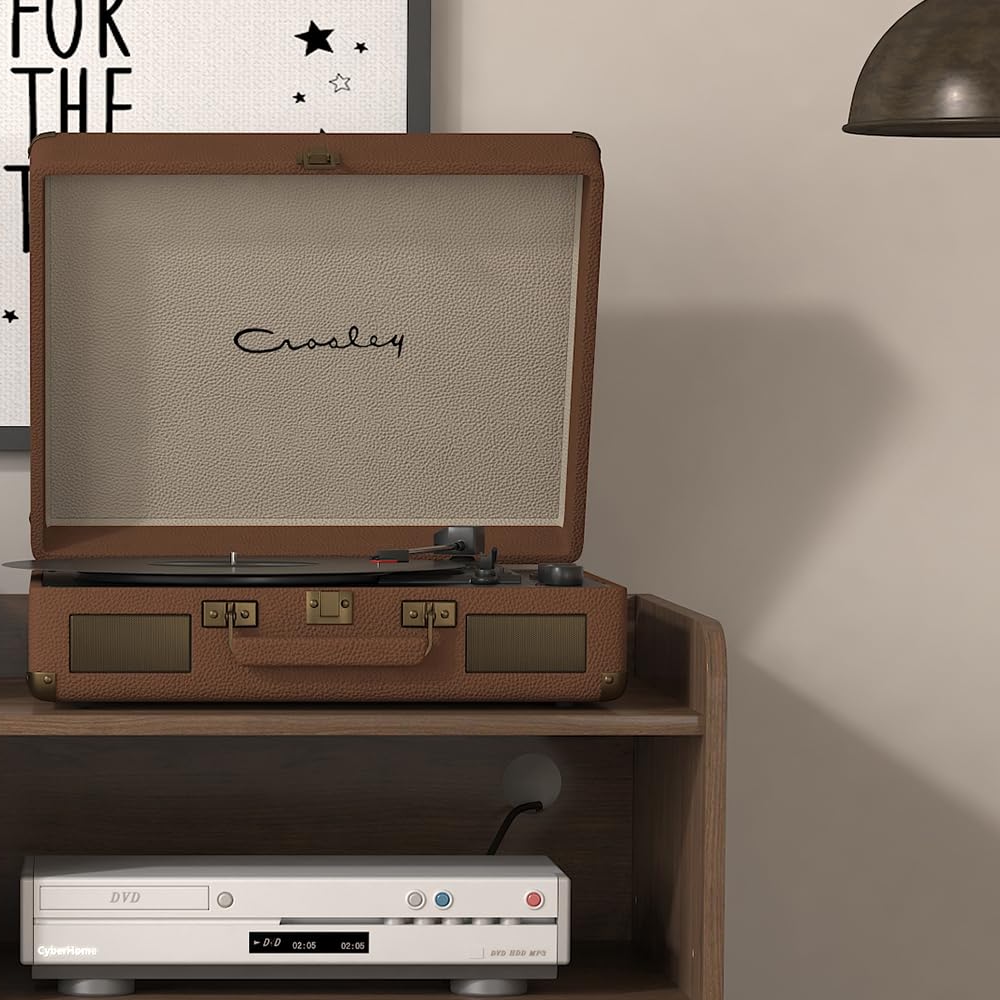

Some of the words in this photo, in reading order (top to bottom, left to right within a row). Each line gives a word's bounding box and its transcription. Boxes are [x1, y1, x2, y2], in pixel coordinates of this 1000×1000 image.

[11, 0, 131, 59] FOR
[233, 325, 405, 358] Crosley
[109, 891, 141, 904] DVD
[37, 945, 97, 957] CyberHome
[292, 941, 317, 950] 02:05
[340, 941, 365, 950] 02:05
